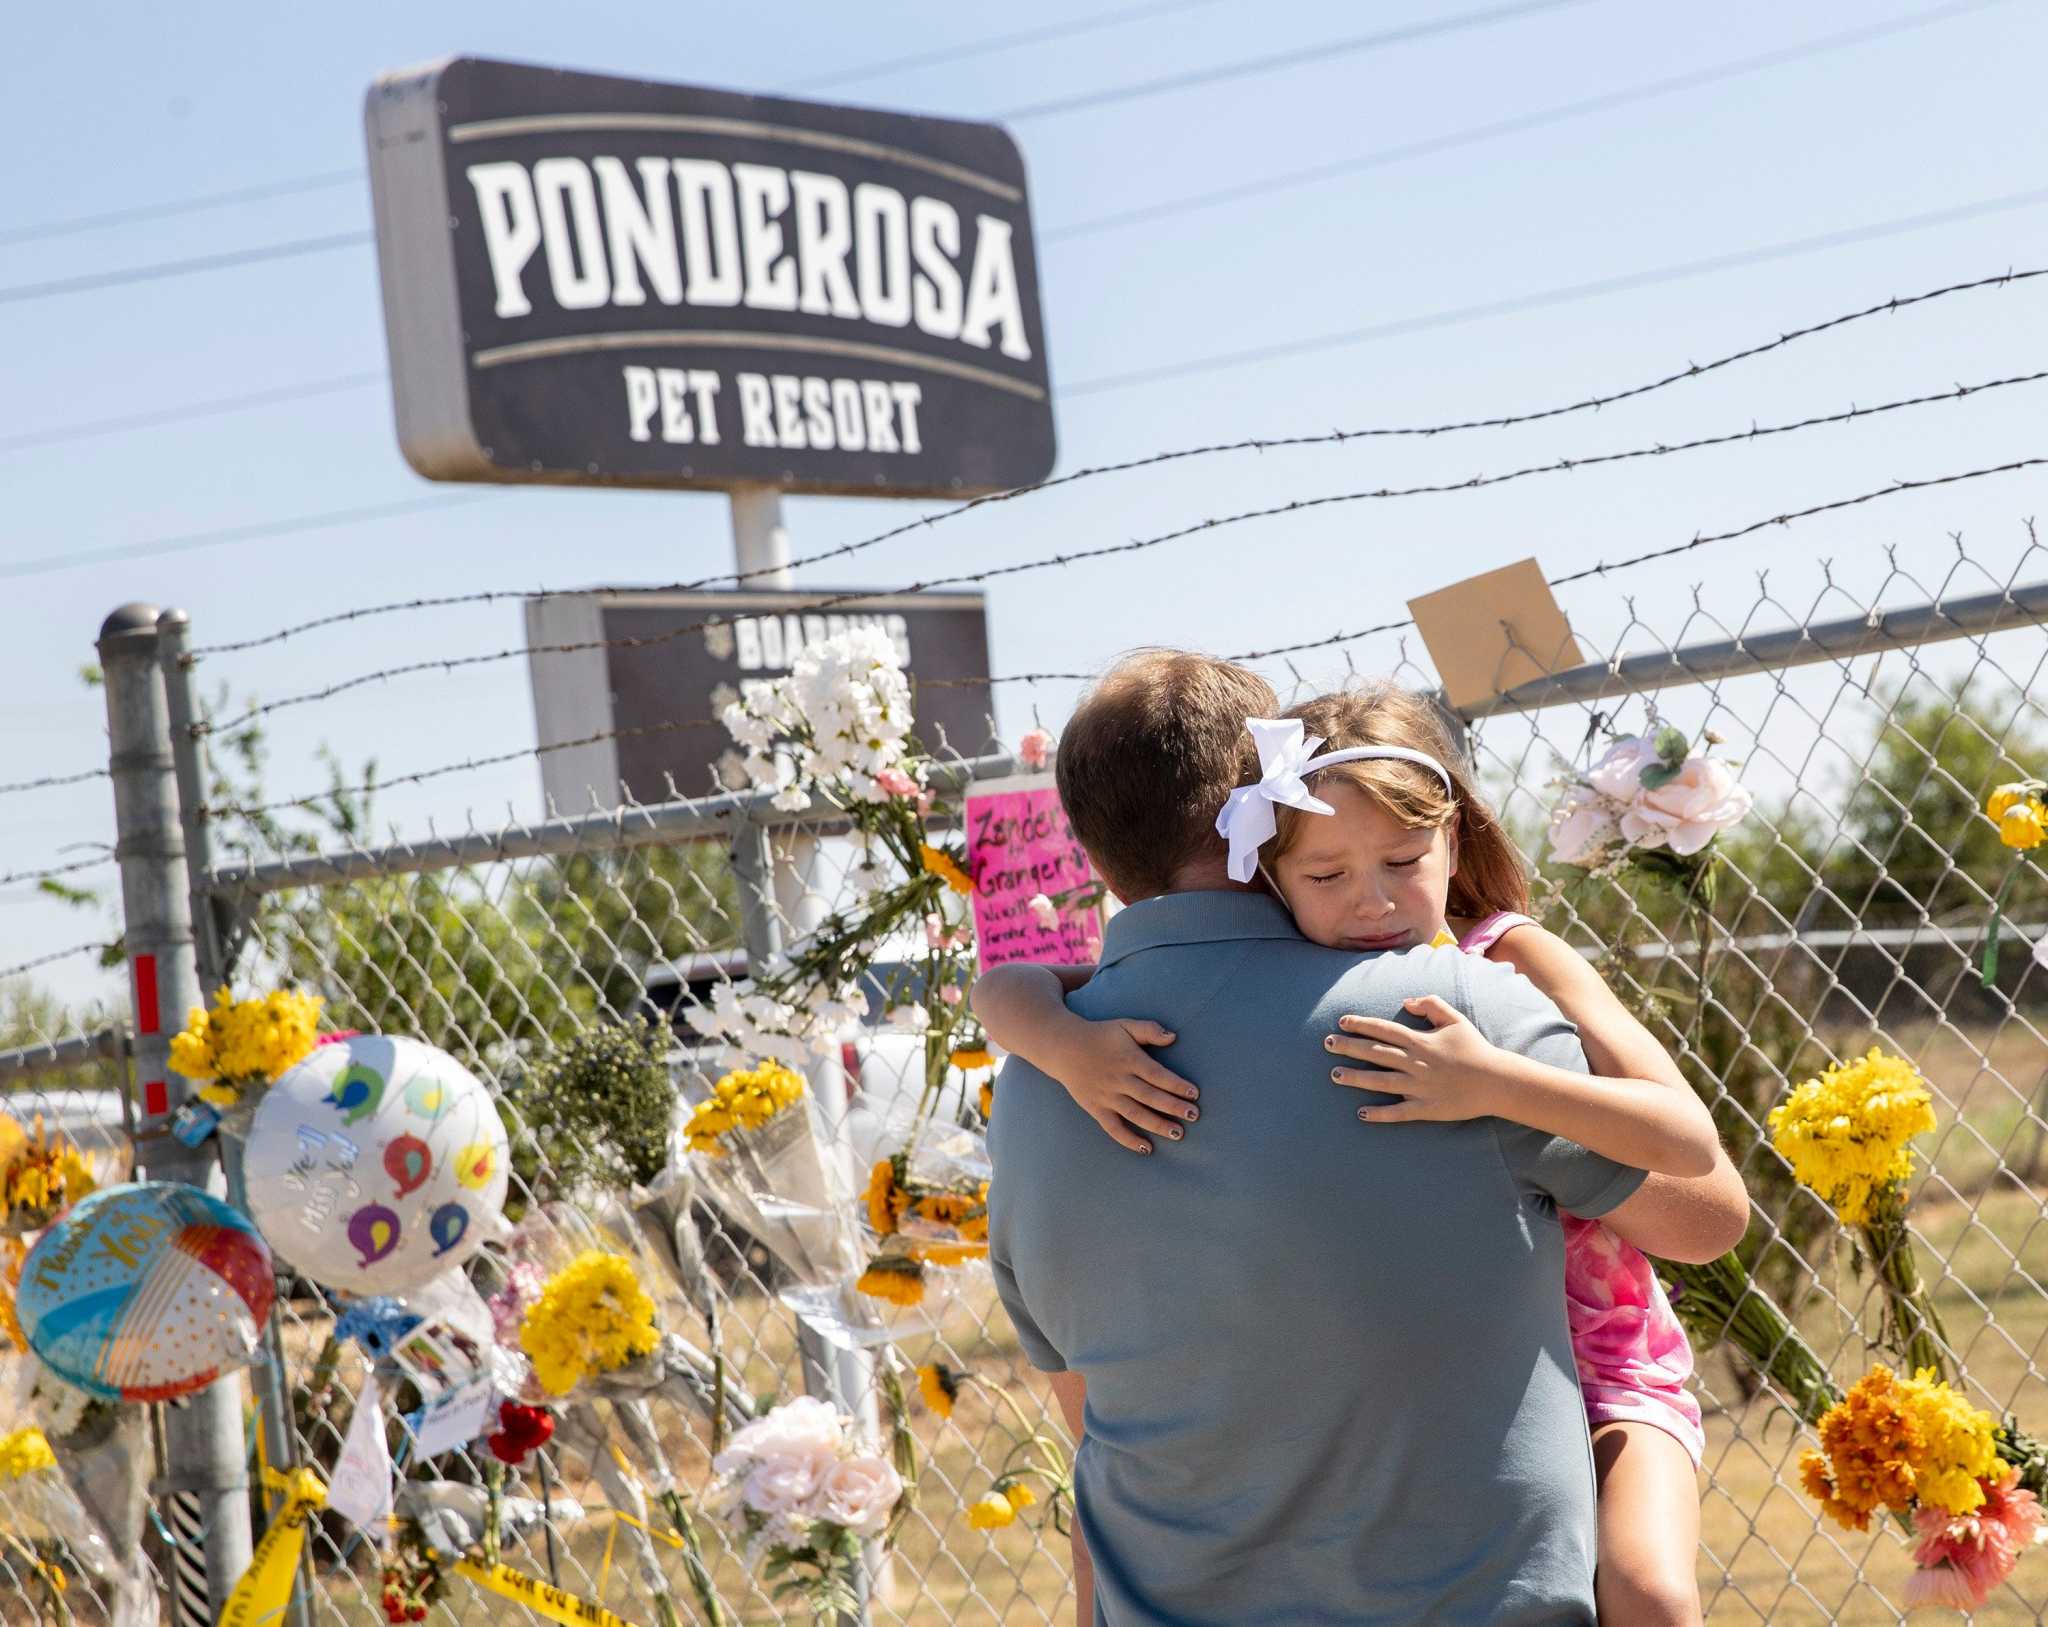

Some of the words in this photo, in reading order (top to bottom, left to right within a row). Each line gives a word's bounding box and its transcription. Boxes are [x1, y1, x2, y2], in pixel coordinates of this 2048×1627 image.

[466, 155, 1033, 361] PONDEROSA
[623, 365, 720, 445] PET
[736, 371, 923, 454] RESORT
